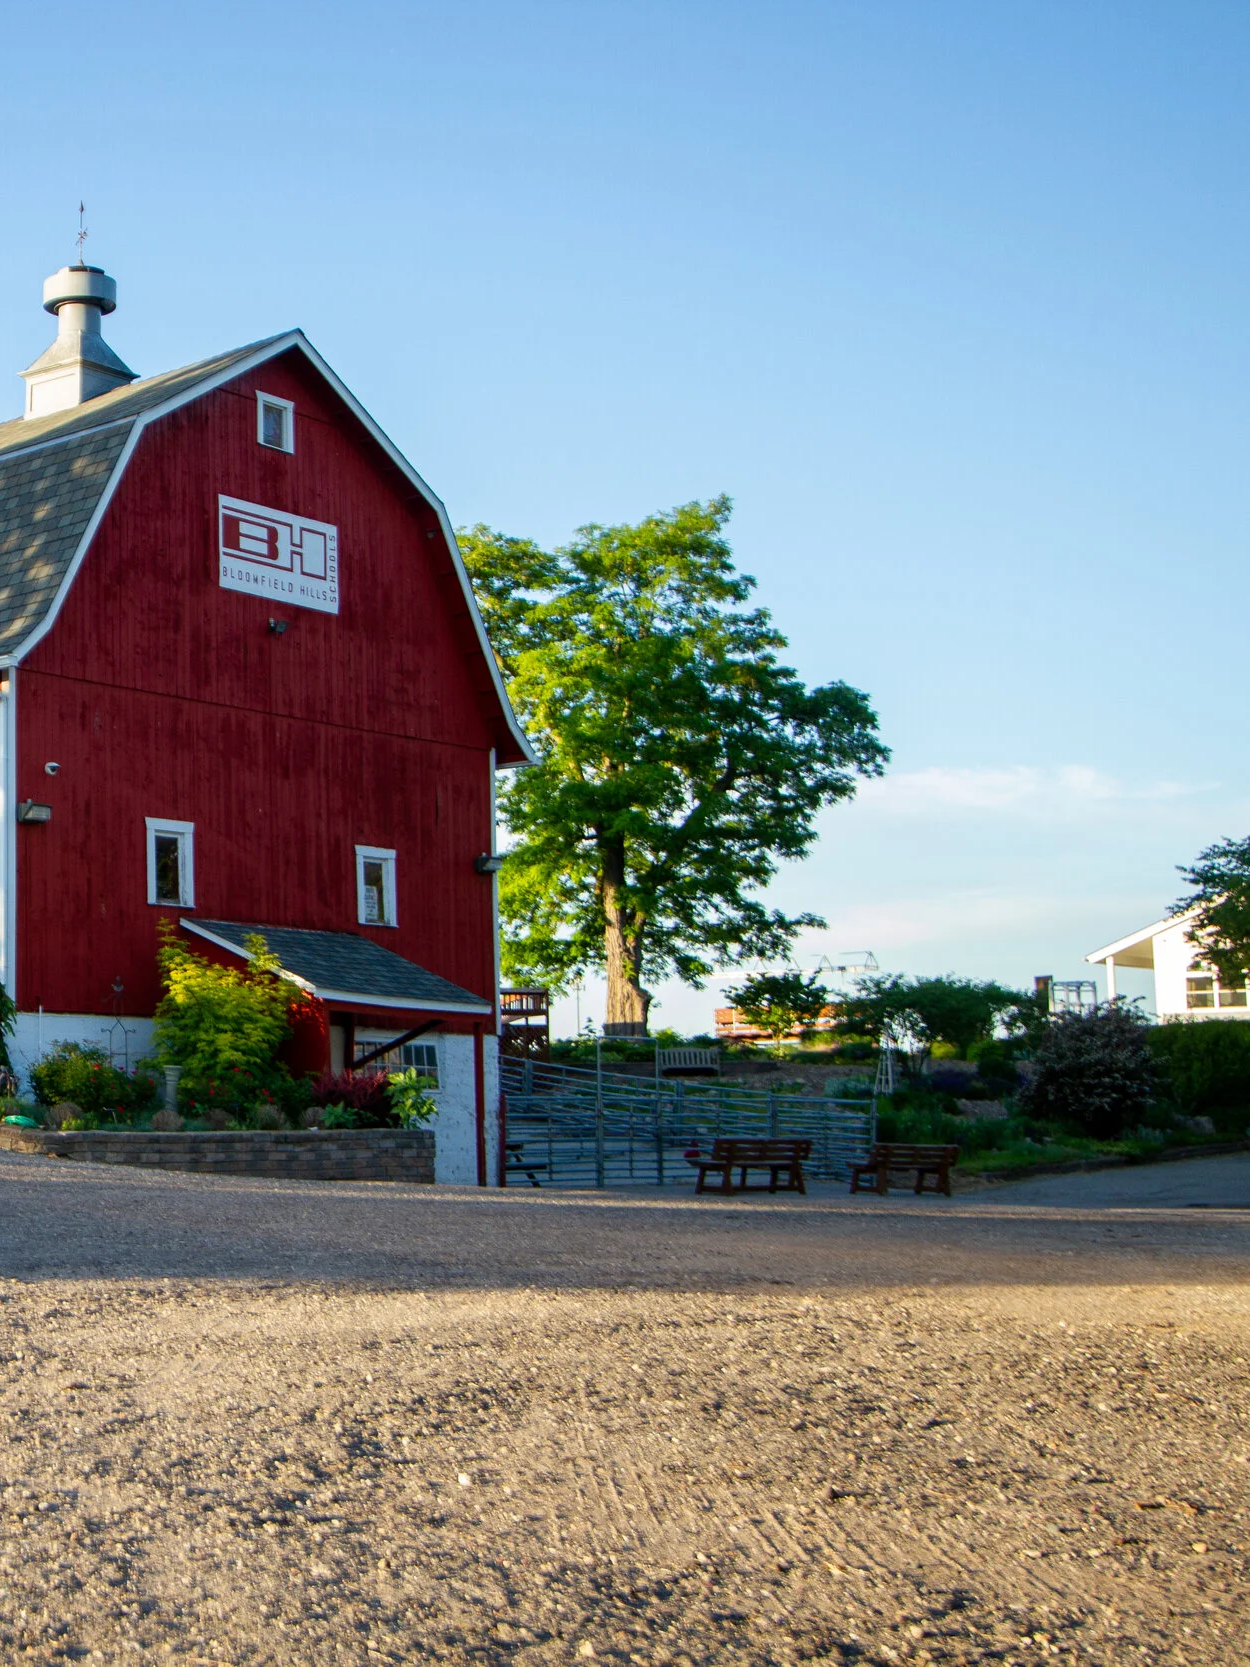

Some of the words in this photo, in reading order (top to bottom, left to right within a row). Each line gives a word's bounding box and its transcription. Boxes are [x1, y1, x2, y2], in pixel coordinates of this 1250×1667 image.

[222, 566, 293, 593] BLOOMFIELD
[300, 585, 327, 601] HILLS
[329, 535, 337, 603] SCHOOLS
